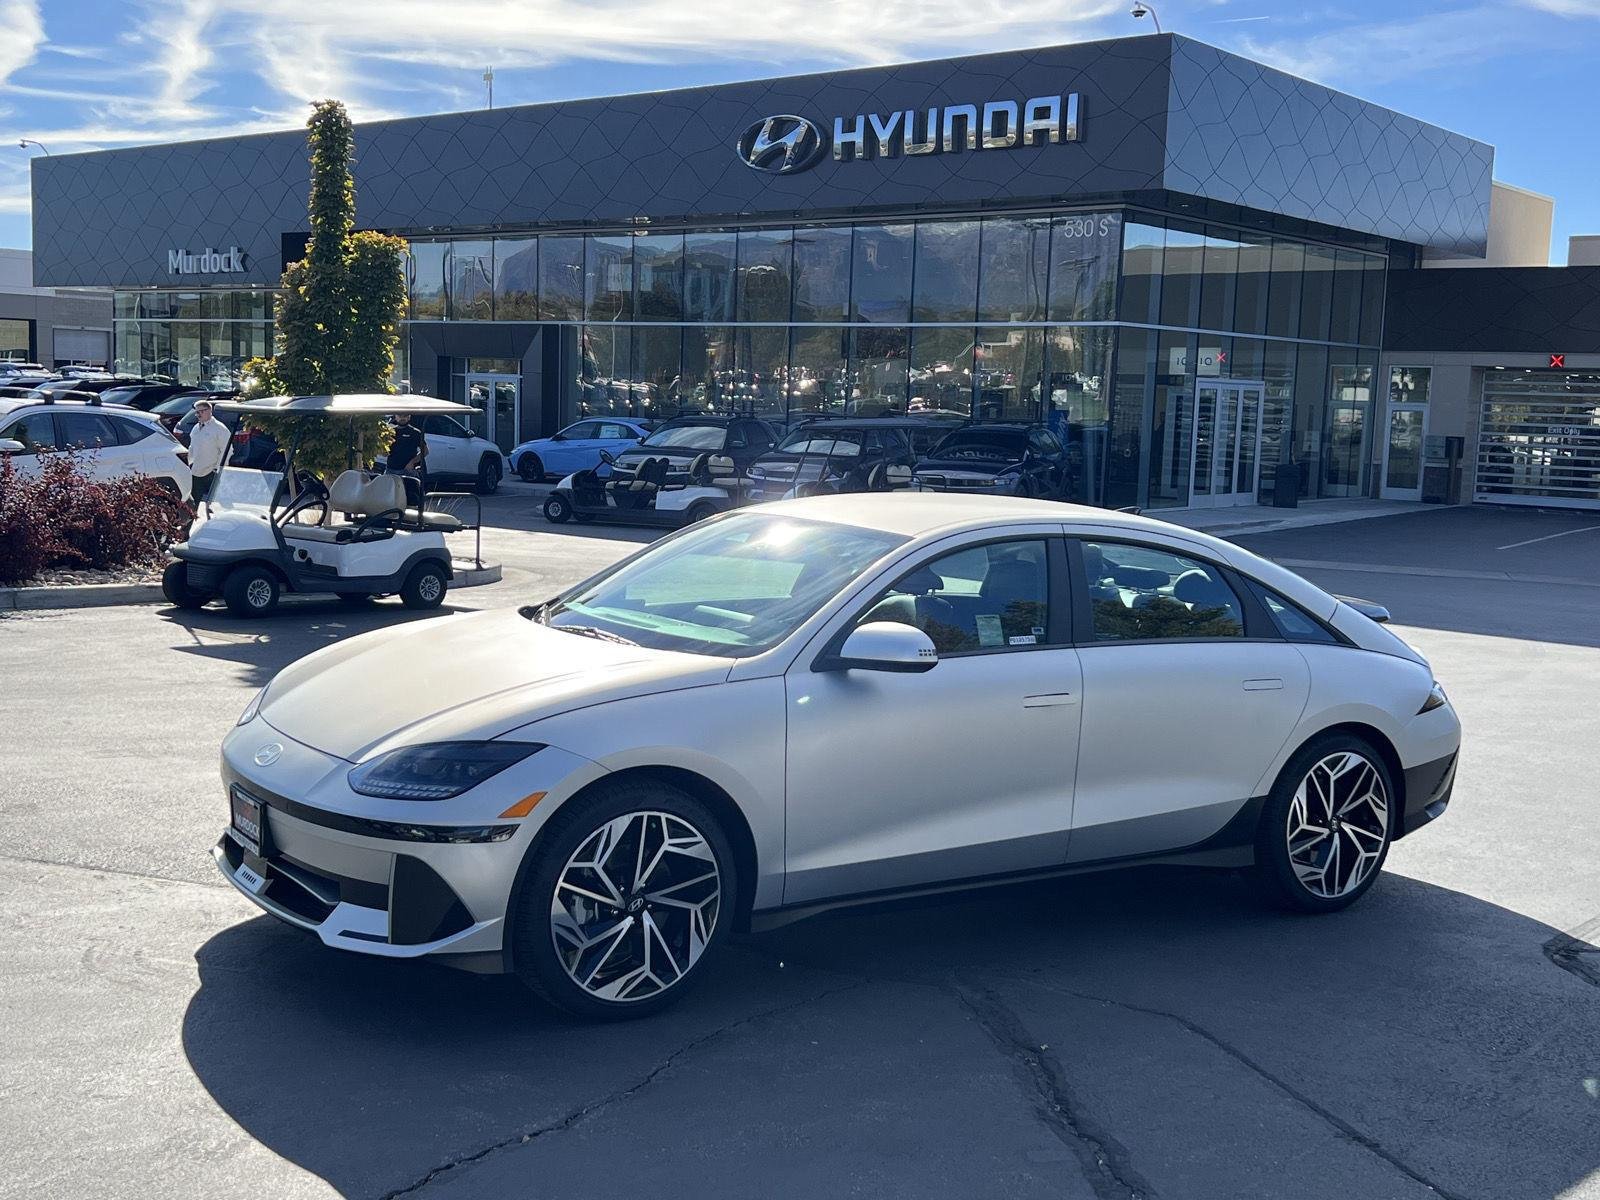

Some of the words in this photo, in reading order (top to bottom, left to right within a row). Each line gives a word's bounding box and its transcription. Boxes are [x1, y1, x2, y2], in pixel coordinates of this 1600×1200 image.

[833, 92, 1080, 161] HYUNDAI
[1064, 219, 1094, 238] 530
[1099, 218, 1109, 237] S
[168, 246, 245, 275] Murdock
